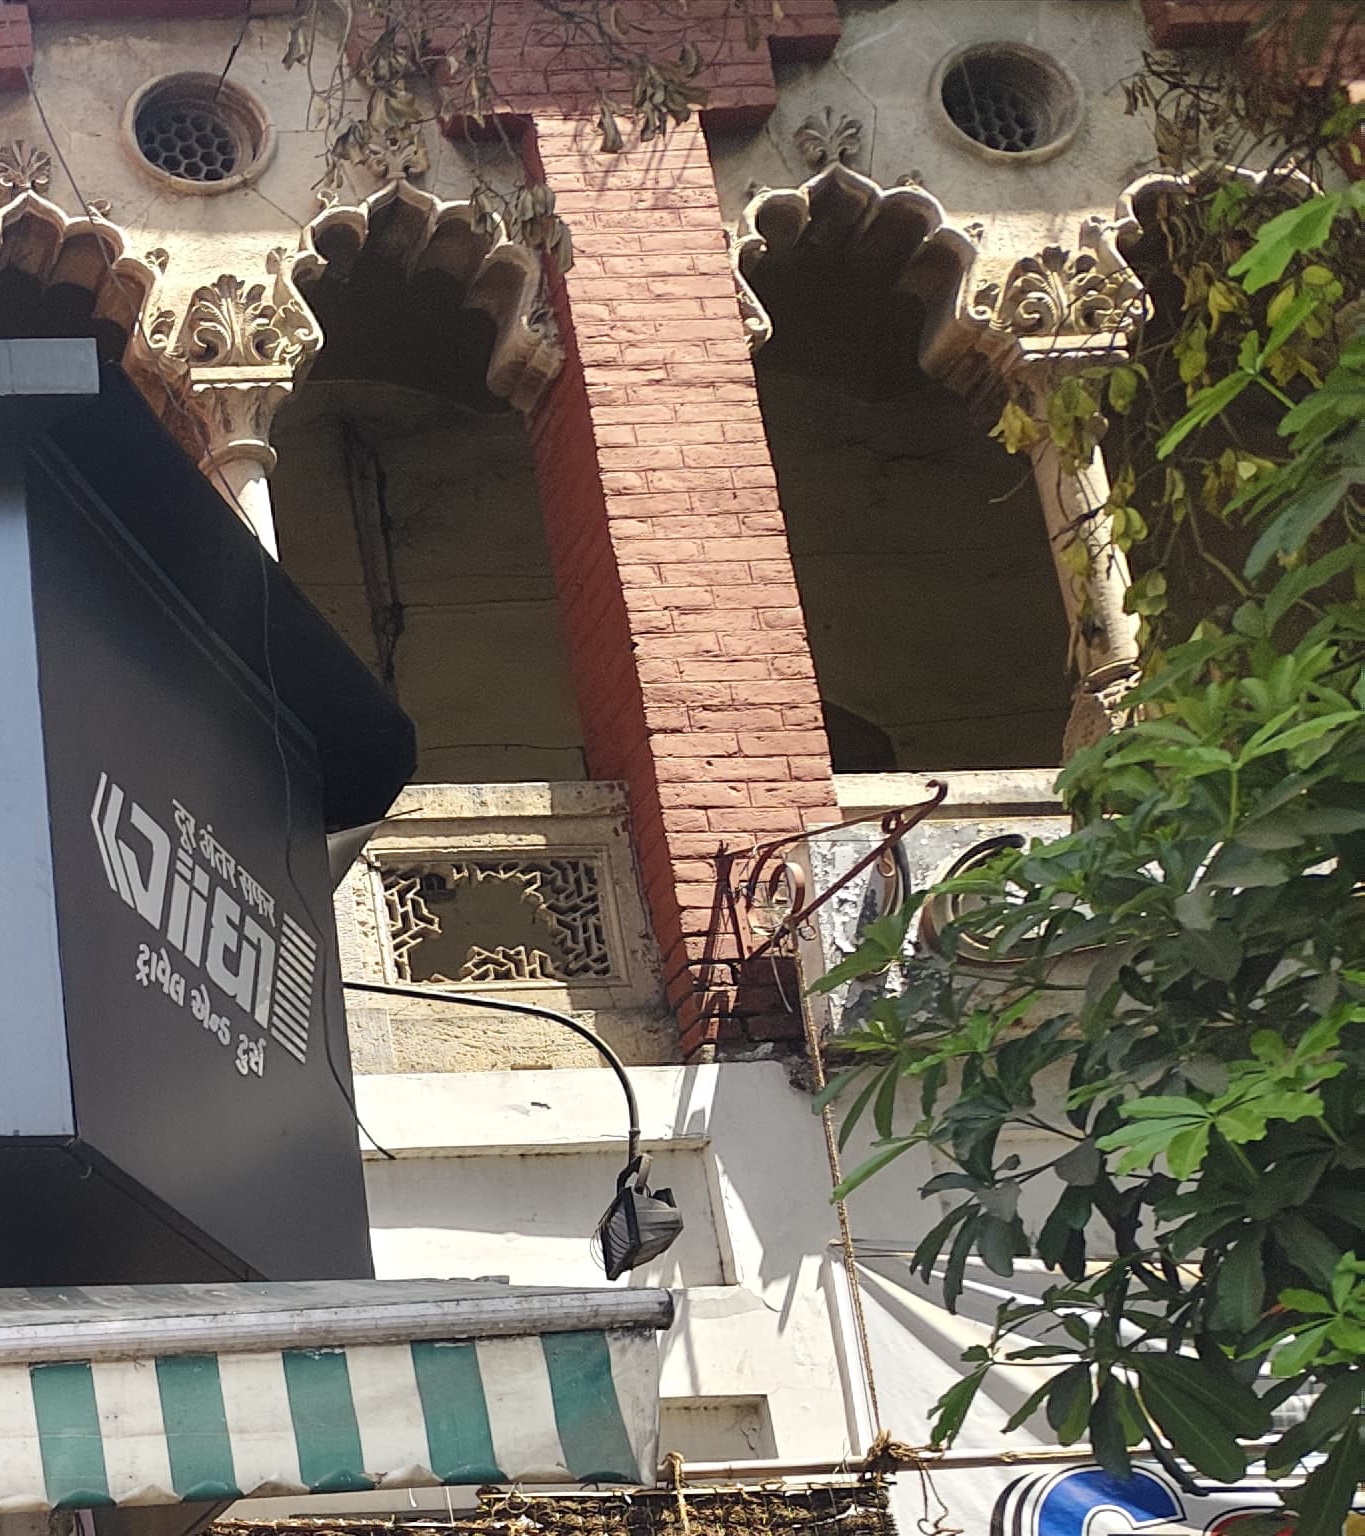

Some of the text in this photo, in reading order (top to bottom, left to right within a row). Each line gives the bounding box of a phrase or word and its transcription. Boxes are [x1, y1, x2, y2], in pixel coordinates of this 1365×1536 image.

[173, 798, 276, 927] दूर अंतर सफर
[136, 943, 186, 1007] ટ્રાવેલ
[190, 984, 231, 1046] એન્ડ
